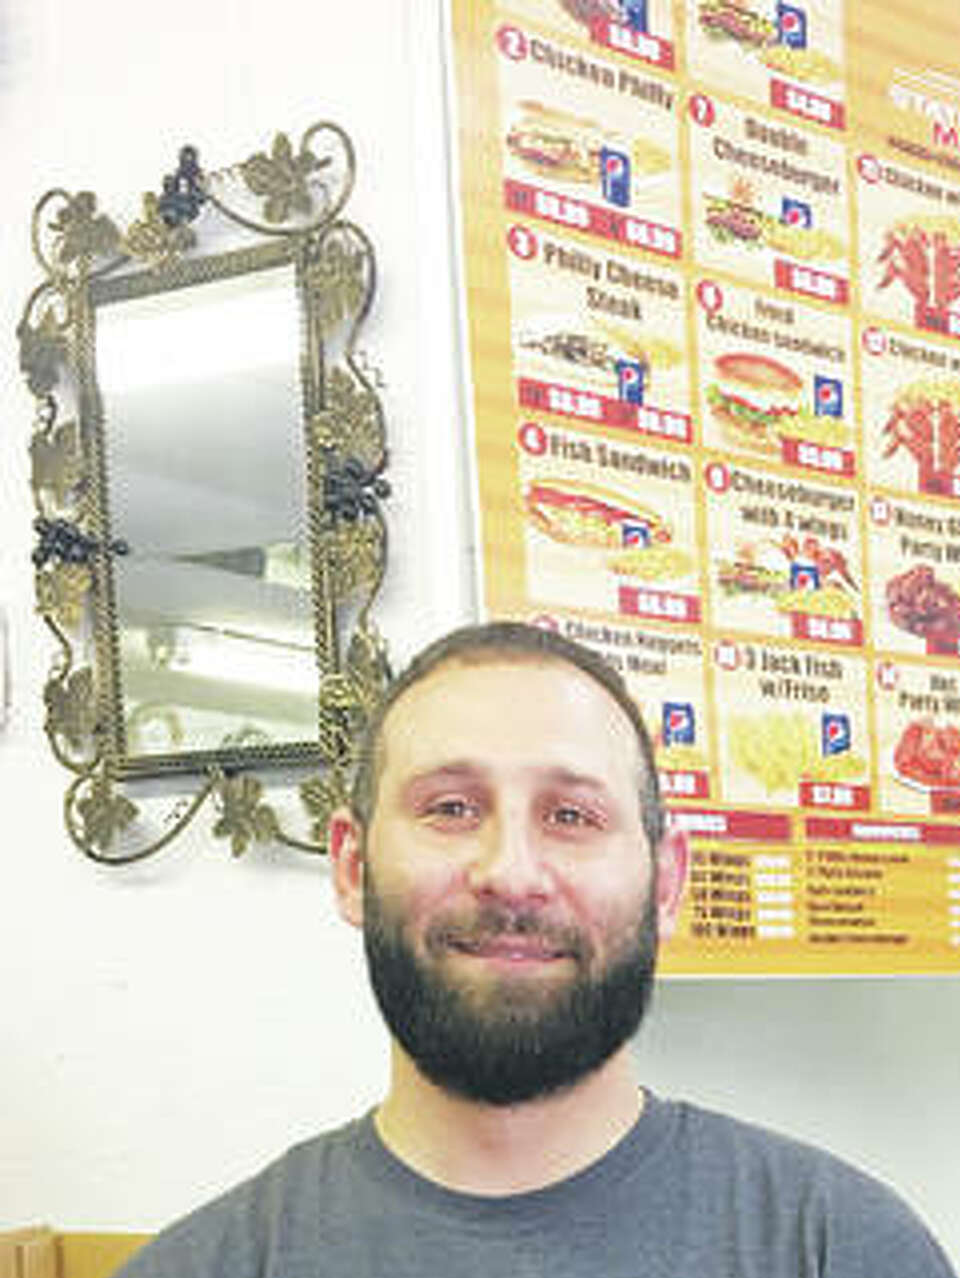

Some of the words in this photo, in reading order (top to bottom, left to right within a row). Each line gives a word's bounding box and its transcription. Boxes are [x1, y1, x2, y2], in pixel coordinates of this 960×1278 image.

[530, 39, 617, 88] Chicken
[619, 66, 674, 111] Philly
[714, 137, 840, 194] Cheeseburger
[543, 244, 601, 281] Philly
[606, 260, 679, 299] Cheese
[586, 286, 643, 320] Steak
[551, 435, 591, 463] Fish
[600, 443, 693, 482] Sandwich
[729, 470, 855, 511] Cheeseburger
[761, 652, 800, 675] Jack
[805, 656, 843, 680] Fish
